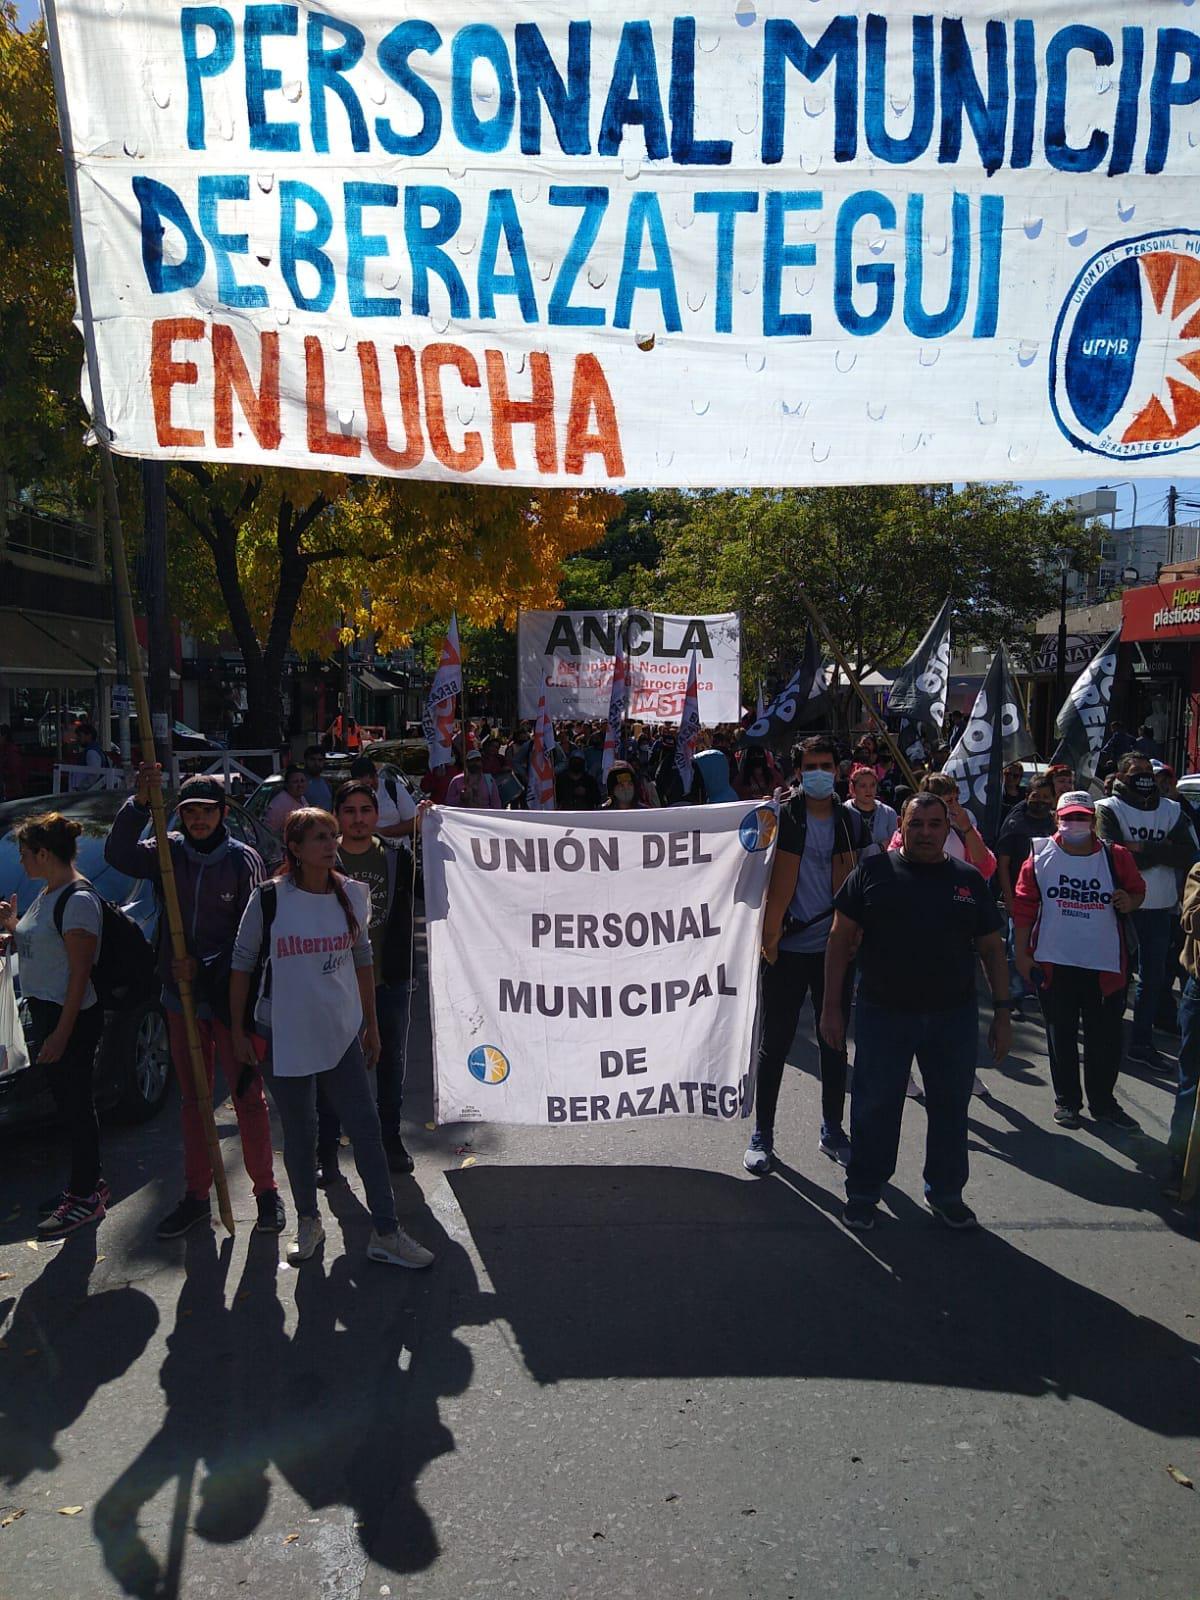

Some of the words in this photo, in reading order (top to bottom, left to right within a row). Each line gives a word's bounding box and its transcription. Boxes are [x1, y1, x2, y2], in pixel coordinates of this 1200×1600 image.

[180, 4, 732, 165] PERSONAL
[762, 13, 1200, 177] MUNICIP
[132, 175, 269, 309] DE
[279, 180, 1004, 338] BERAZATEGUI
[1072, 272, 1097, 303] UNION
[1096, 252, 1119, 273] DEL
[1125, 240, 1178, 256] PERSONAL
[1082, 339, 1128, 356] UPMB
[151, 318, 281, 451] EN
[304, 335, 625, 478] LUCHA
[1100, 440, 1179, 454] BERAZATEGUI
[1172, 588, 1200, 608] Hiper
[1153, 607, 1200, 630] plásticos
[544, 613, 714, 658] ANCLA
[640, 662, 701, 674] Nacionl
[635, 691, 686, 714] MST
[470, 829, 620, 873] UNIÓN
[642, 830, 712, 870] DEL
[1047, 886, 1113, 904] OBRERO
[1058, 874, 1101, 890] POLO
[531, 903, 721, 948] PERSONAL
[499, 963, 737, 1019] MUNICIPAL
[600, 1047, 648, 1079] DE
